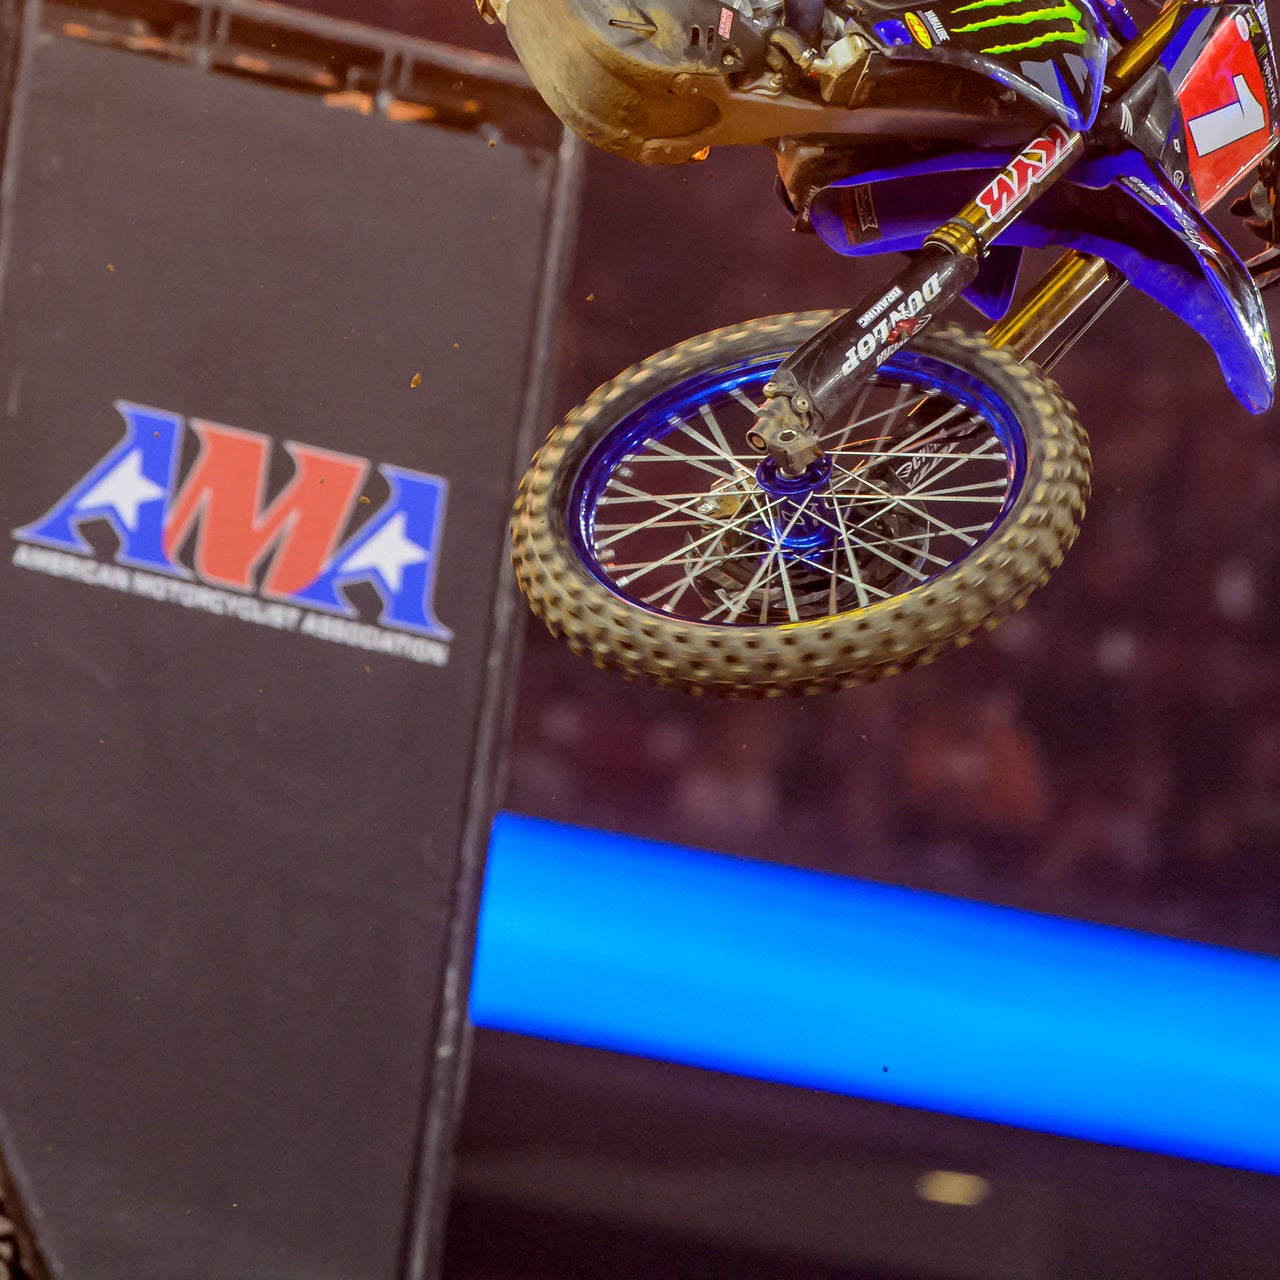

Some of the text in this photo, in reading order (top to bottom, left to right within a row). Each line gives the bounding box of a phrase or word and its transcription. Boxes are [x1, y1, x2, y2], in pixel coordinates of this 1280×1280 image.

[1187, 74, 1266, 158] 1
[842, 271, 943, 377] DUNLOP
[857, 285, 904, 329] BRAKING
[10, 398, 454, 641] AMA
[11, 544, 451, 667] AMERICAN MOTORCYCLIST ASSOCIATION
